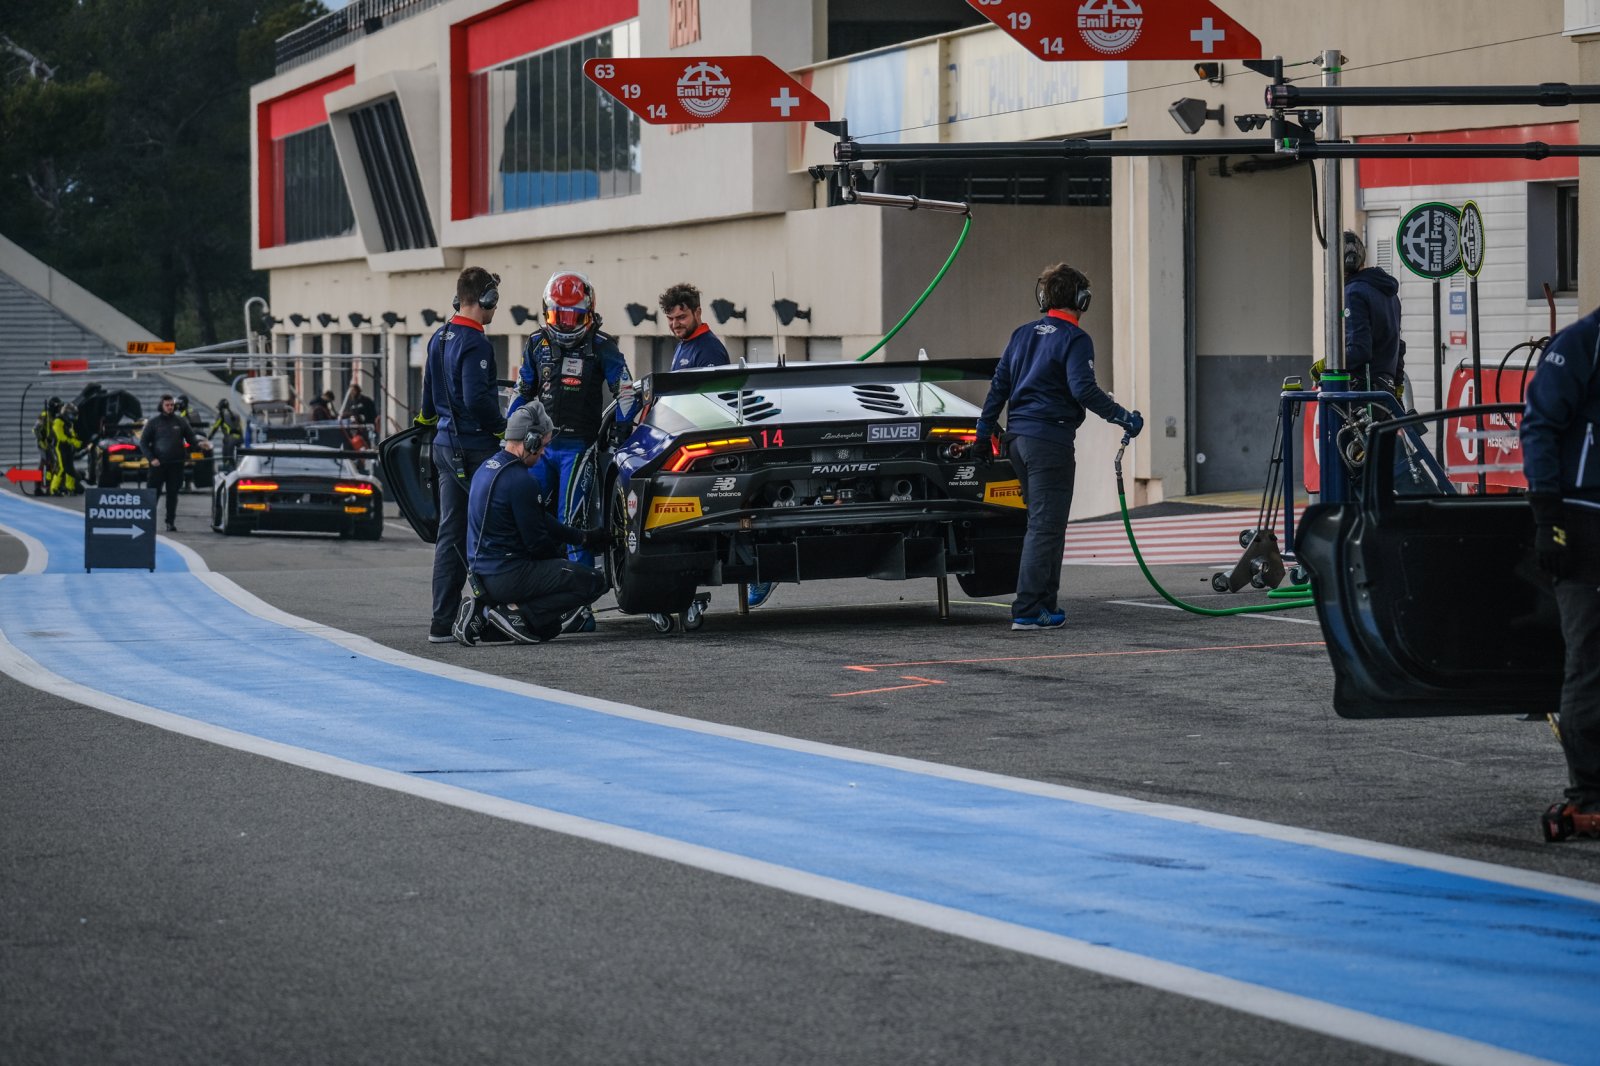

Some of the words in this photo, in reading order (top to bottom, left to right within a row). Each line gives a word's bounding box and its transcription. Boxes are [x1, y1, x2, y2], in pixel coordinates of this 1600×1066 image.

[1007, 12, 1031, 30] 19
[1077, 15, 1109, 28] Emil
[1111, 15, 1143, 30] Frey
[1039, 37, 1065, 55] 14
[594, 64, 615, 79] 63
[620, 84, 641, 99] 19
[676, 86, 703, 97] Emil
[705, 86, 732, 98] Frey
[647, 104, 668, 119] 14
[1430, 210, 1445, 239] Frey
[1430, 242, 1442, 271] Emil
[760, 429, 785, 448] 14
[871, 426, 917, 439] SILVER
[811, 463, 880, 474] FANATEC
[99, 493, 141, 505] ACCÈS
[990, 485, 1022, 498] PIREL
[89, 508, 152, 520] PADDOCK
[654, 502, 695, 514] PIRELLI
